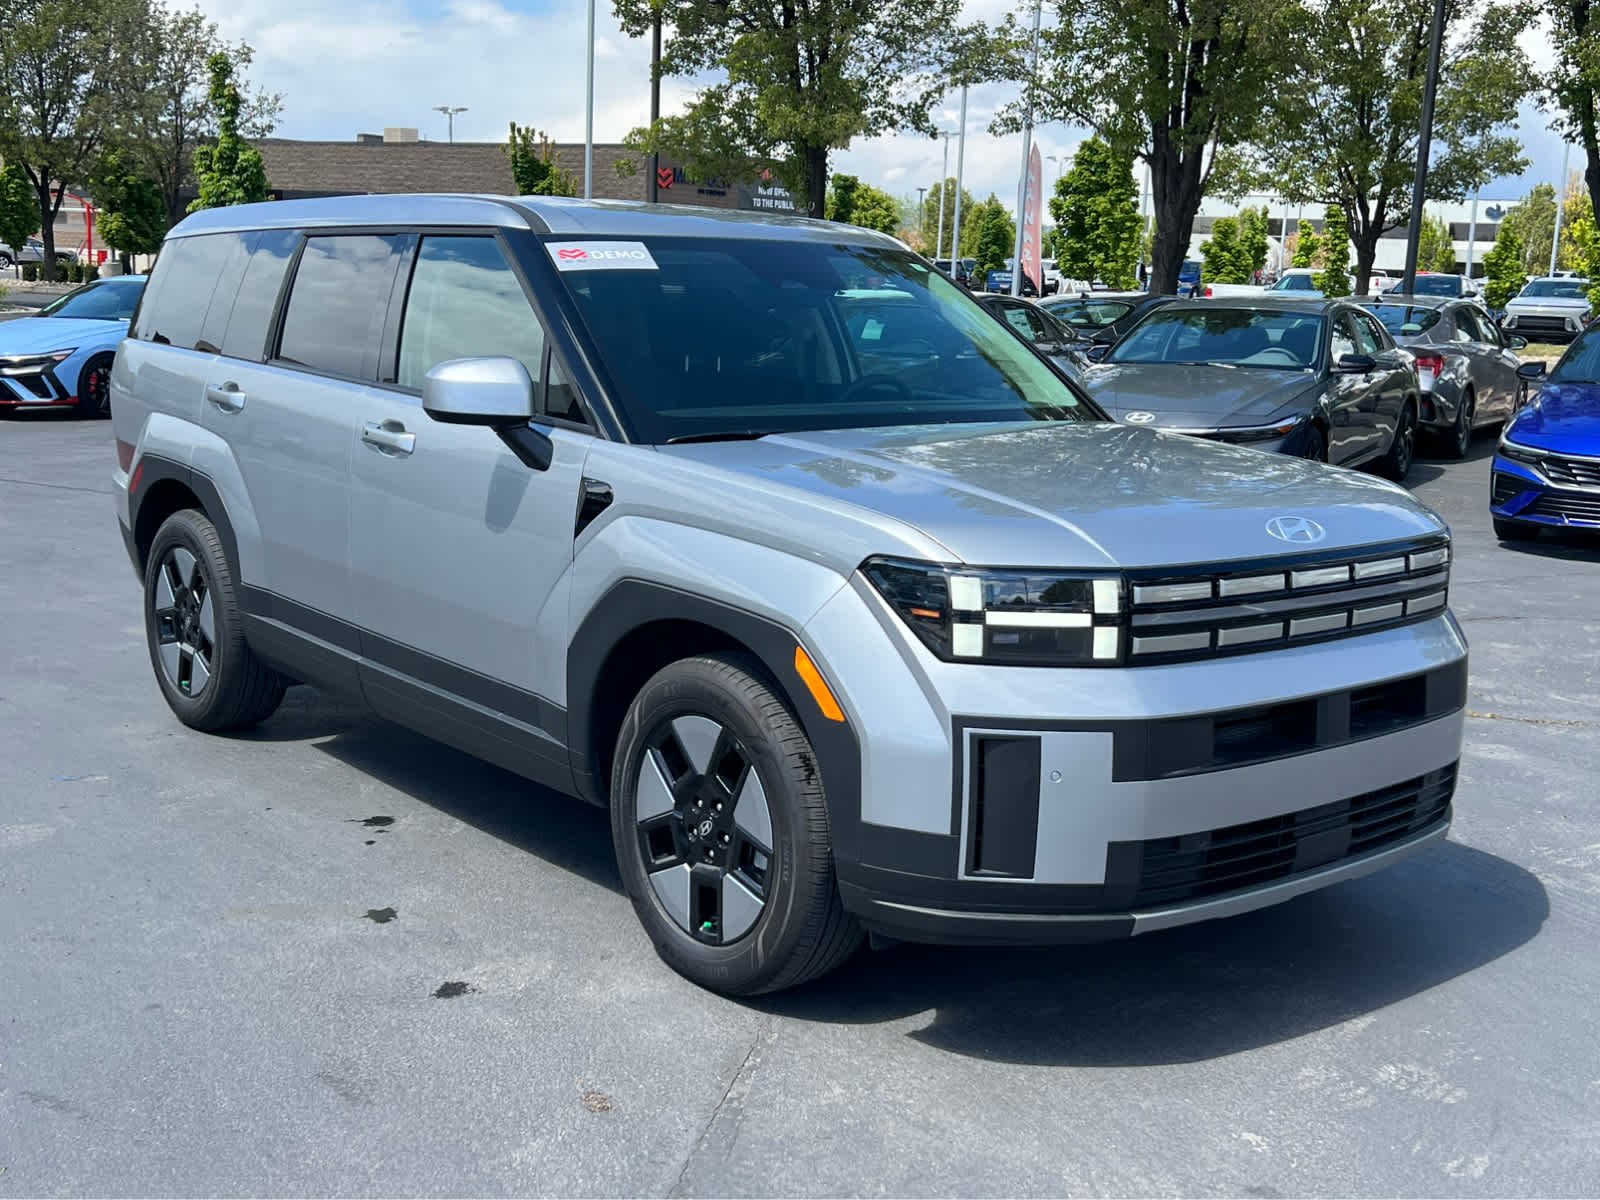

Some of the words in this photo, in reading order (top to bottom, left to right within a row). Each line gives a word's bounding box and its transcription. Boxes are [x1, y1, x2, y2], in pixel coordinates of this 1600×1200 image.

[753, 198, 761, 207] TO
[762, 198, 773, 208] THE
[590, 250, 645, 260] DEMO
